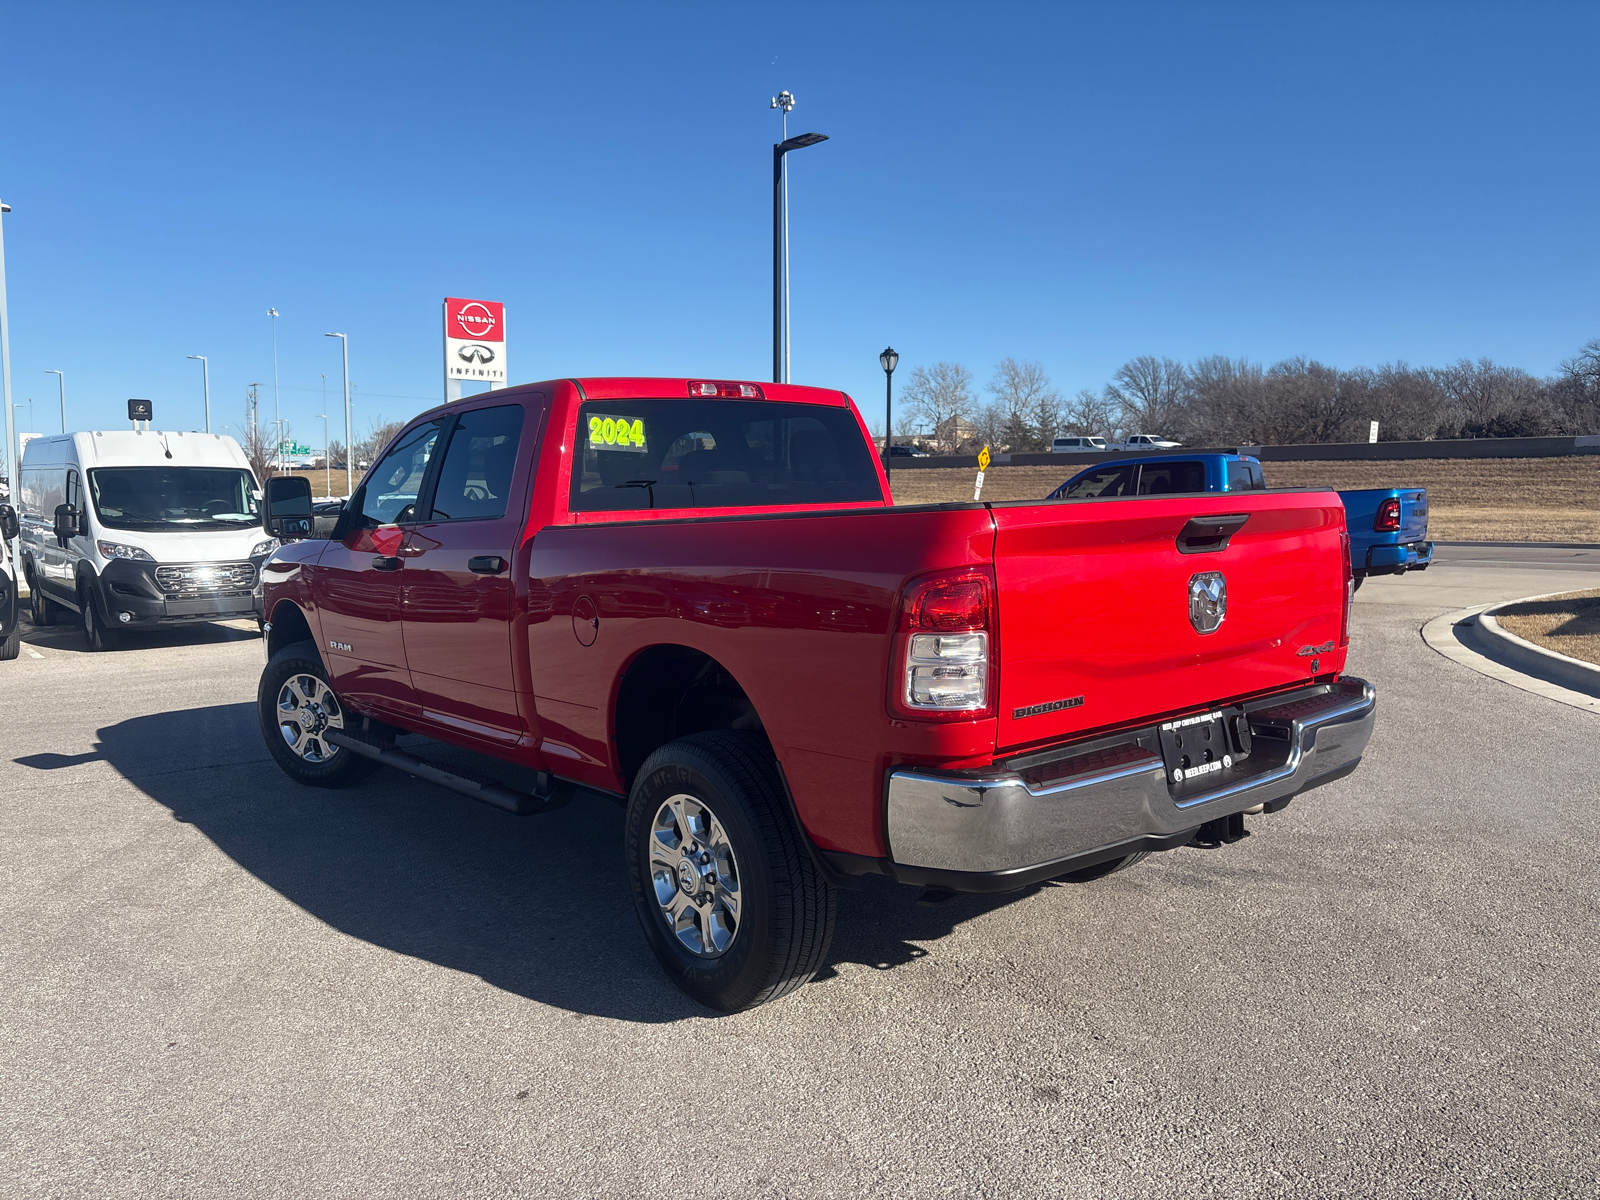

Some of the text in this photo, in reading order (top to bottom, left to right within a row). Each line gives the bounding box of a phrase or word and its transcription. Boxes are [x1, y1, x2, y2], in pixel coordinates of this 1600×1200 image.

[457, 314, 496, 325] NISSAN
[450, 367, 503, 378] INFINITI
[589, 416, 645, 448] 2024
[330, 640, 353, 652] RAM
[1012, 695, 1085, 720] BIGHORN
